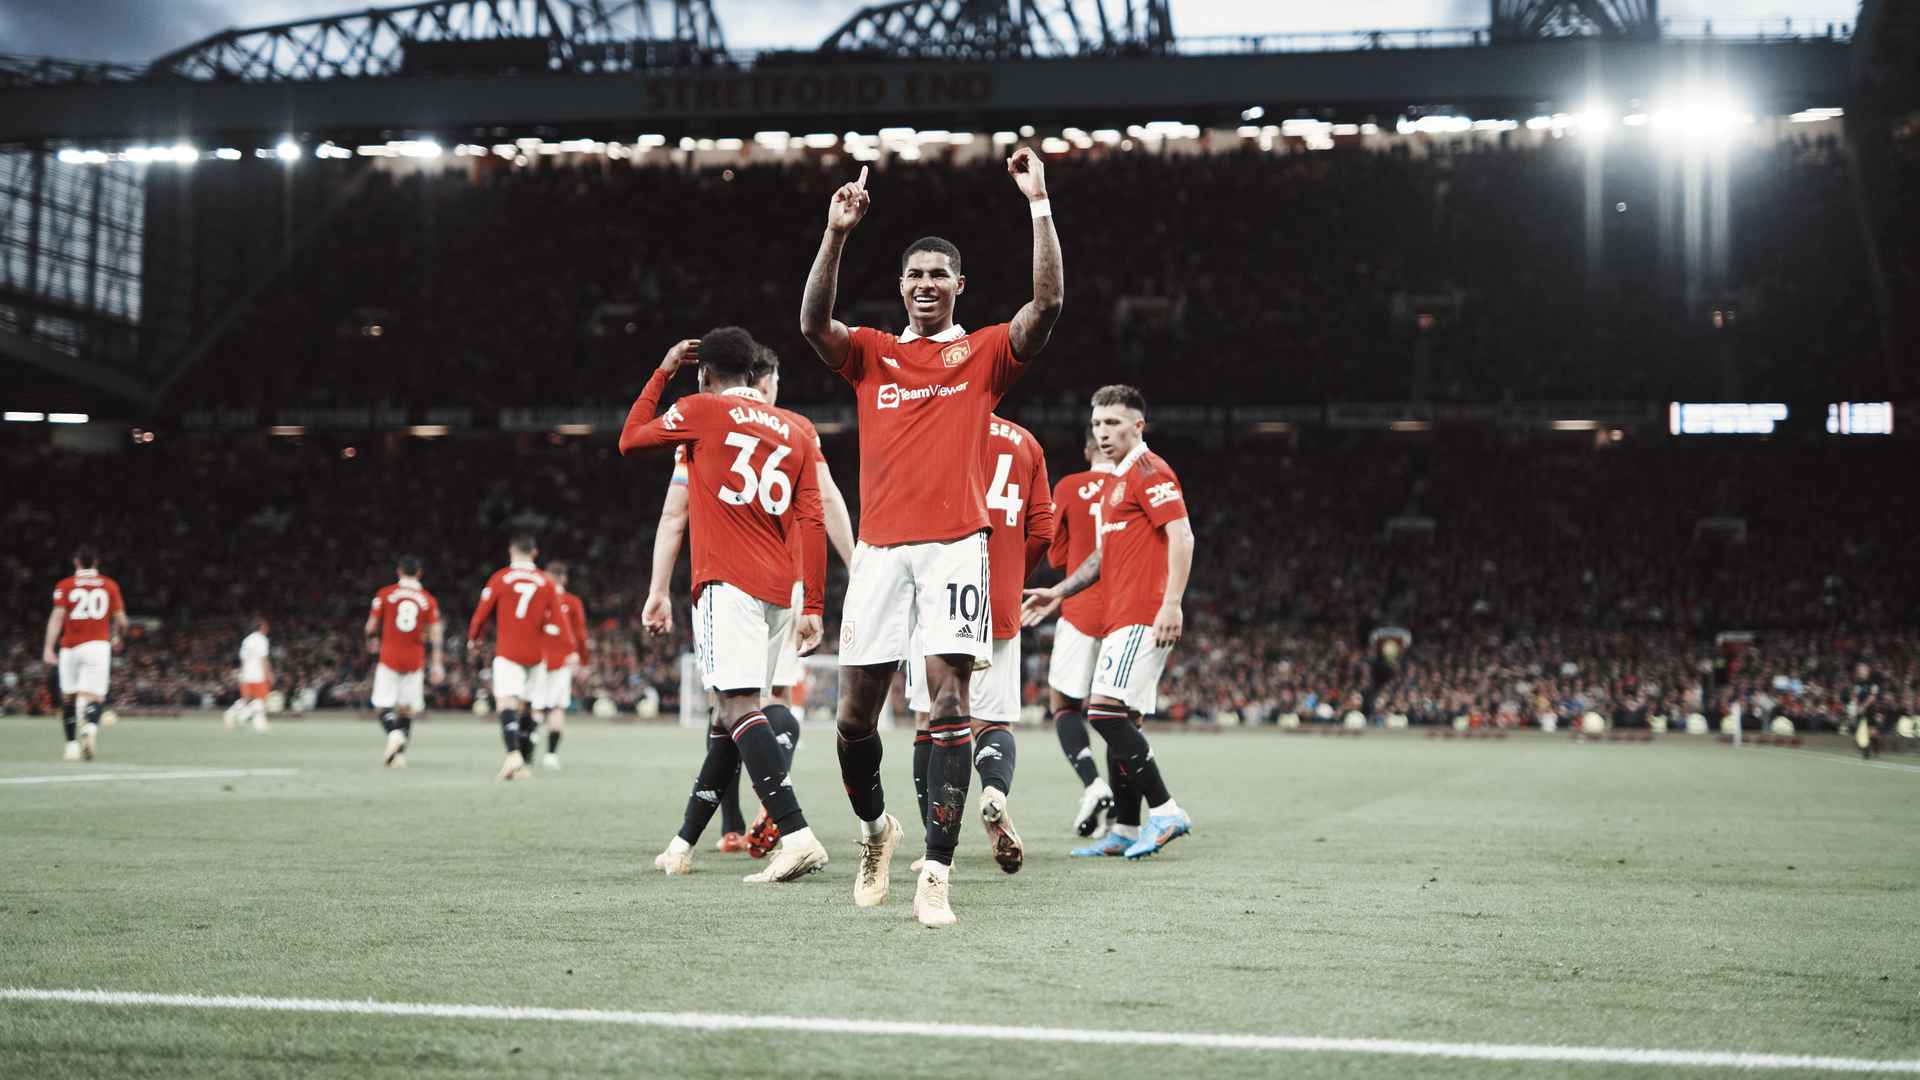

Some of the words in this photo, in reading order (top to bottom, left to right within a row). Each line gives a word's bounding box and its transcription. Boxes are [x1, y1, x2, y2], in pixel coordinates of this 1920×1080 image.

[645, 75, 886, 111] STRETFORD
[905, 71, 992, 105] END
[899, 381, 969, 401] TeamViewer
[728, 406, 790, 440] ELANGA
[718, 432, 792, 516] 36
[986, 454, 1023, 526] 4
[1089, 495, 1104, 550] 1
[68, 588, 110, 620] 20
[395, 599, 419, 632] 8
[514, 582, 537, 619] 7
[946, 583, 980, 622] 10
